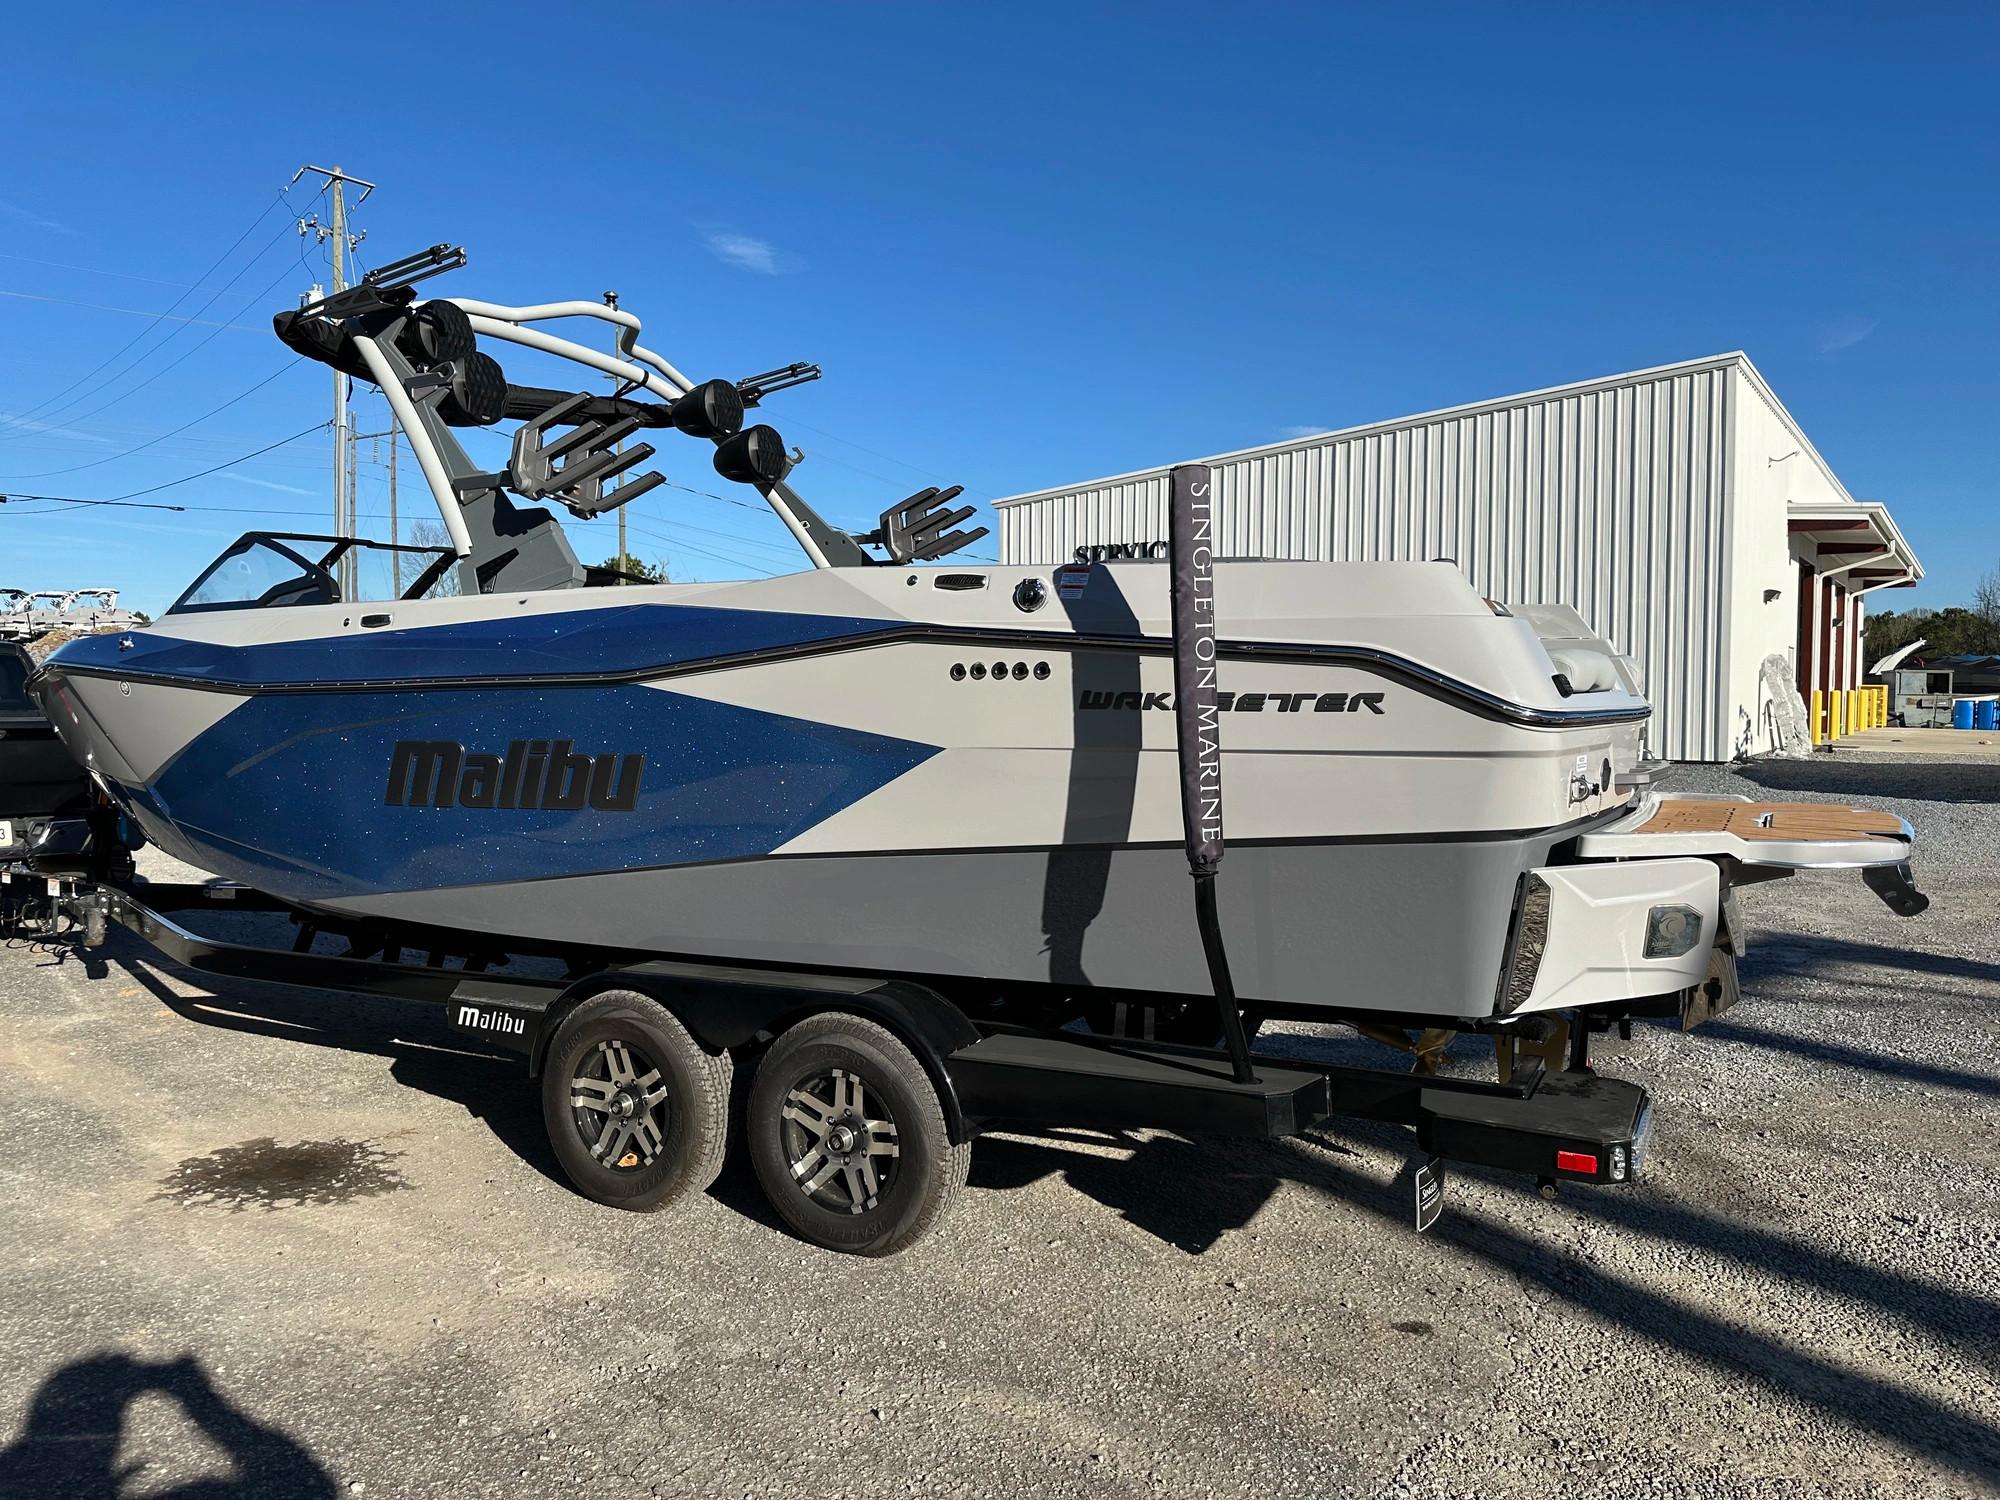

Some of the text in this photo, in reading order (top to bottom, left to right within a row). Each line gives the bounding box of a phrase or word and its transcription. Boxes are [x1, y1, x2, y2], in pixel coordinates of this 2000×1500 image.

[1074, 541, 1170, 563] SERVIC
[1190, 482, 1221, 842] SINGLETON MARINE
[1079, 691, 1386, 715] WAKSETTER
